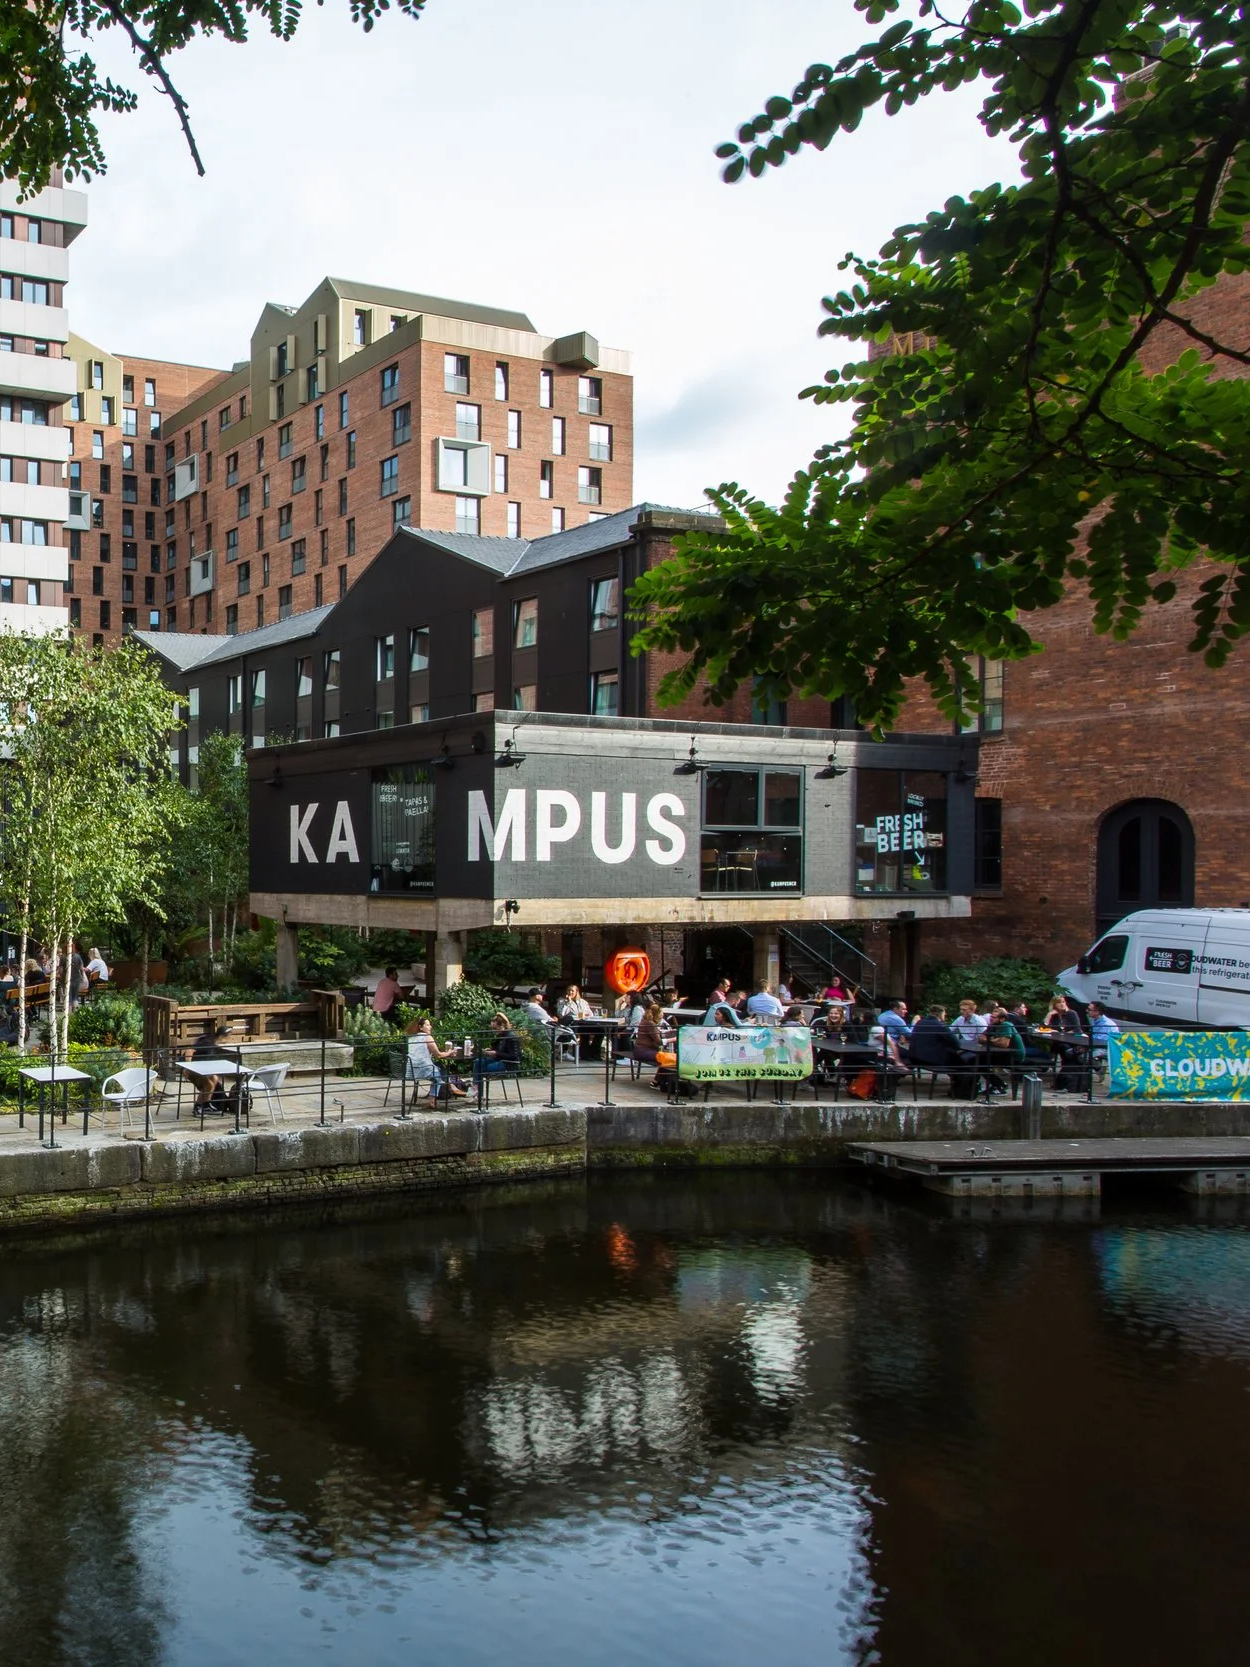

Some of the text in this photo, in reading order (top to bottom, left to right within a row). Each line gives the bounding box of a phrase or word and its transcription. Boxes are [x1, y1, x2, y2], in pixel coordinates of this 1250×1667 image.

[876, 813, 923, 833] FRESH
[877, 830, 925, 853] BEER
[1153, 960, 1172, 968] BEER
[1192, 966, 1207, 975] this
[706, 1032, 741, 1042] KAMPUS
[696, 1069, 717, 1079] JOIN
[718, 1069, 731, 1077] US
[734, 1068, 757, 1077] THIS
